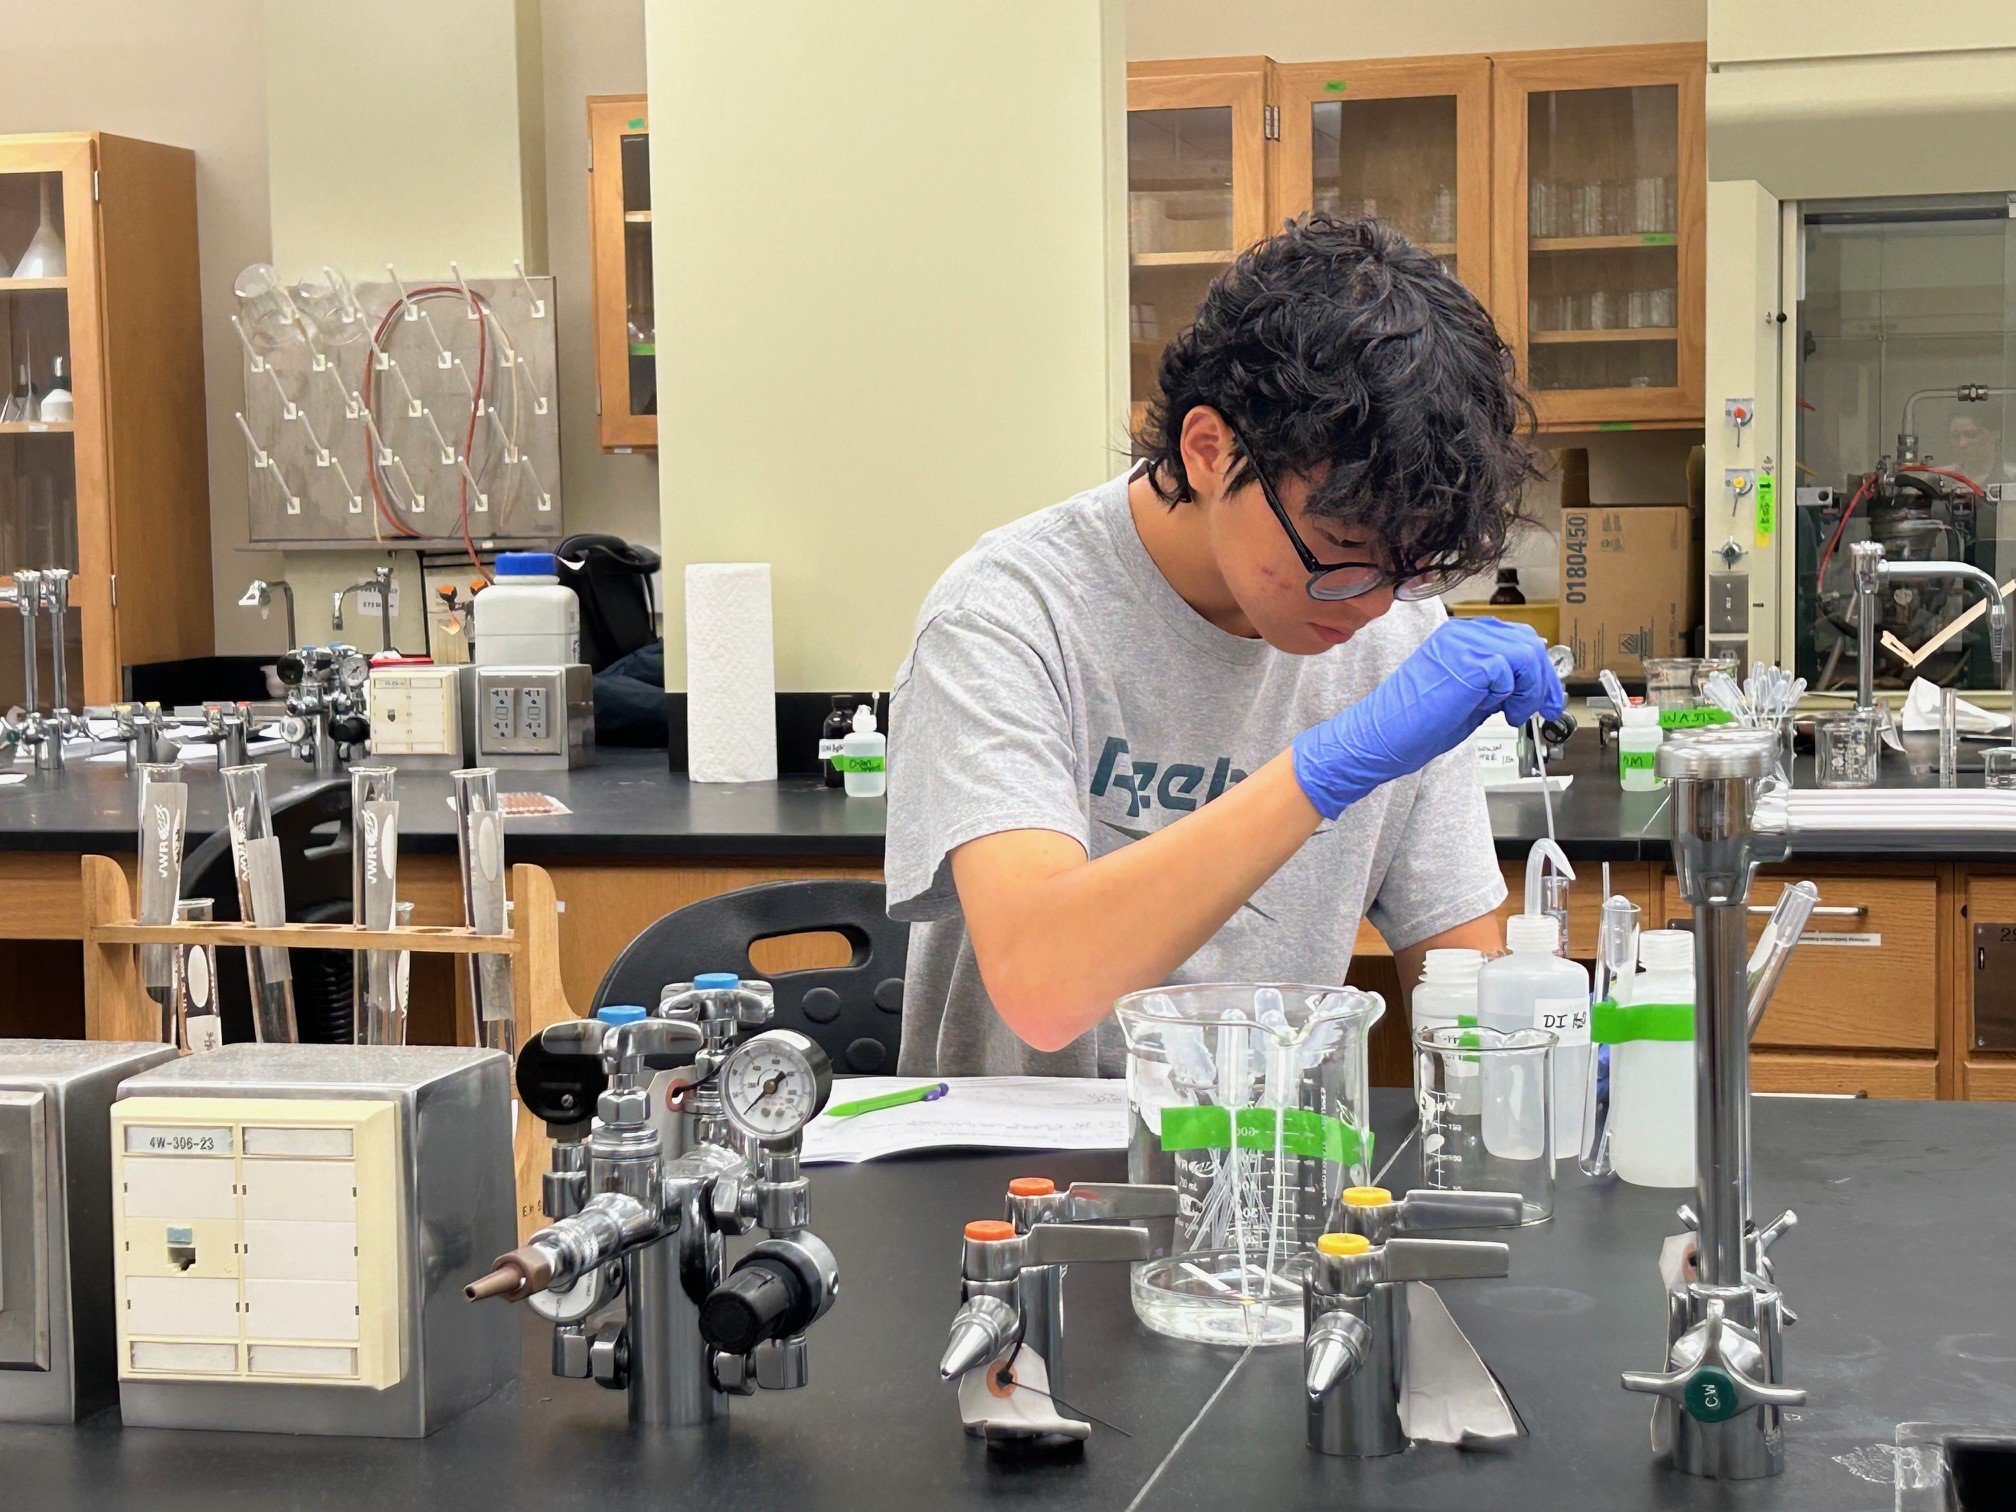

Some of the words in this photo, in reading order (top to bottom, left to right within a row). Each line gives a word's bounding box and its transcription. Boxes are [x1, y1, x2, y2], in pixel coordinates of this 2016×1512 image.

[1566, 516, 1587, 604] 0180450
[1090, 736, 1248, 817] Reeb
[1543, 1014, 1568, 1029] DI
[149, 1136, 214, 1151] 4W-306-23
